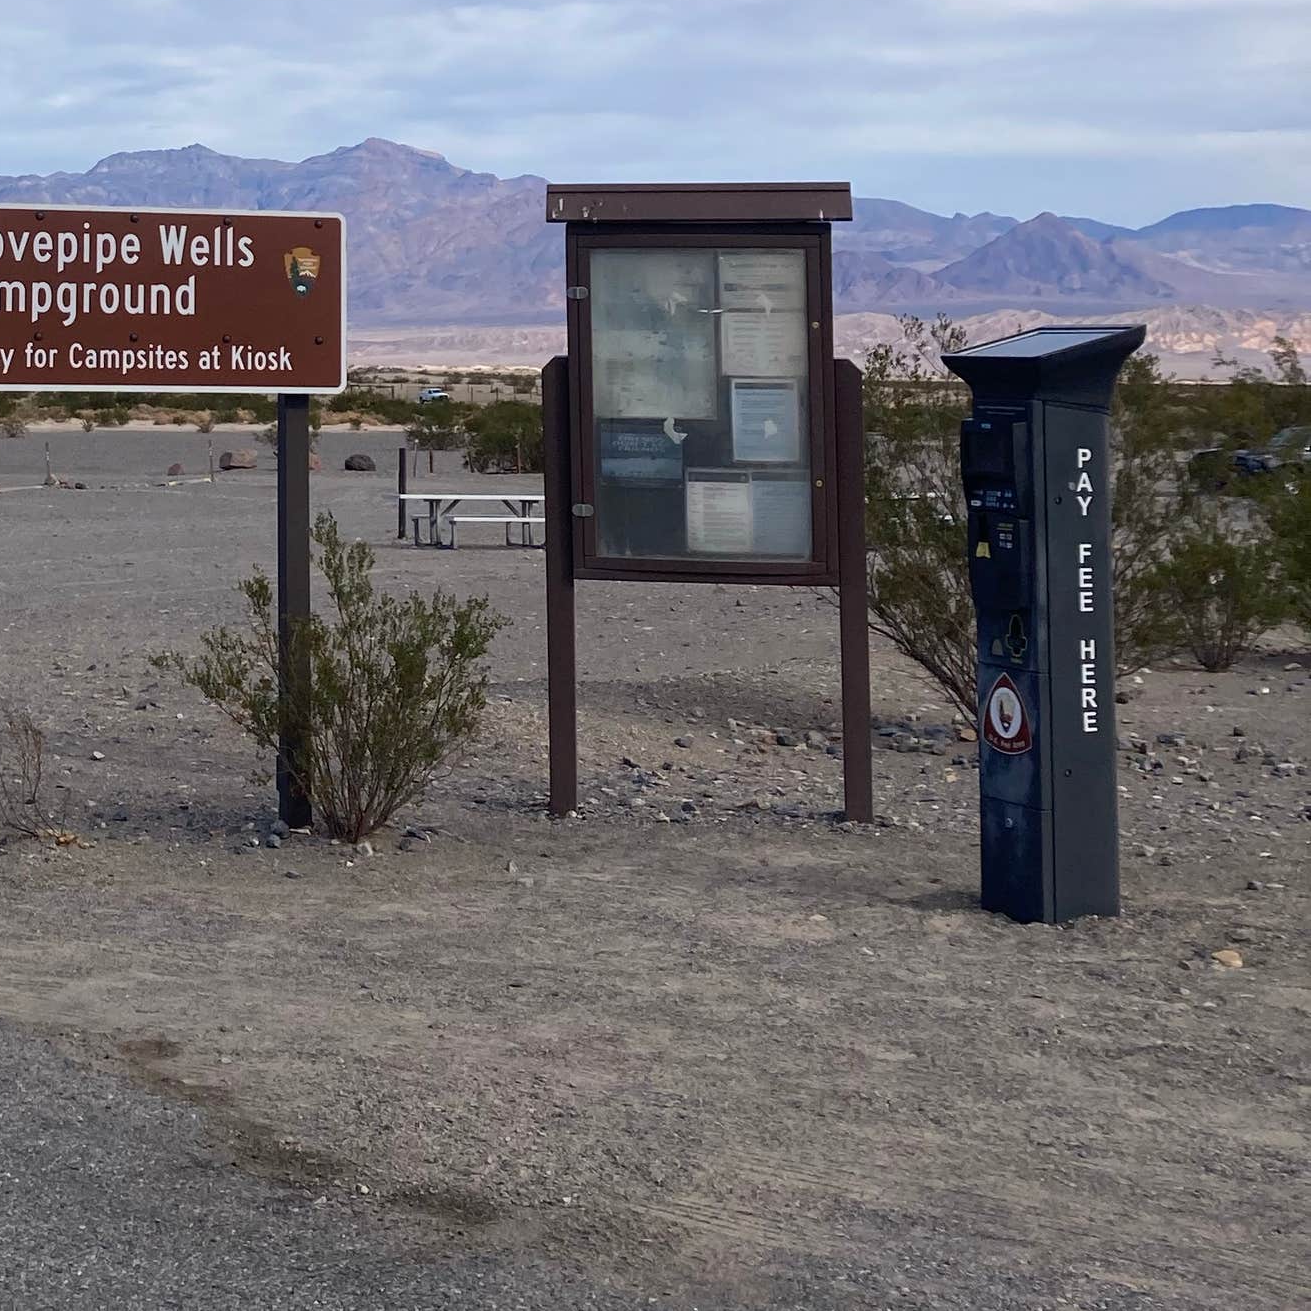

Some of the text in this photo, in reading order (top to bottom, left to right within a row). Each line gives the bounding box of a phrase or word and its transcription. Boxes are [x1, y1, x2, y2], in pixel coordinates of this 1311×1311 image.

[159, 225, 255, 268] Wells
[25, 342, 58, 369] for
[69, 342, 190, 375] Campsites
[198, 346, 221, 371] at
[231, 344, 294, 372] Kiosk
[1077, 448, 1098, 733] PAY FEE HERE
